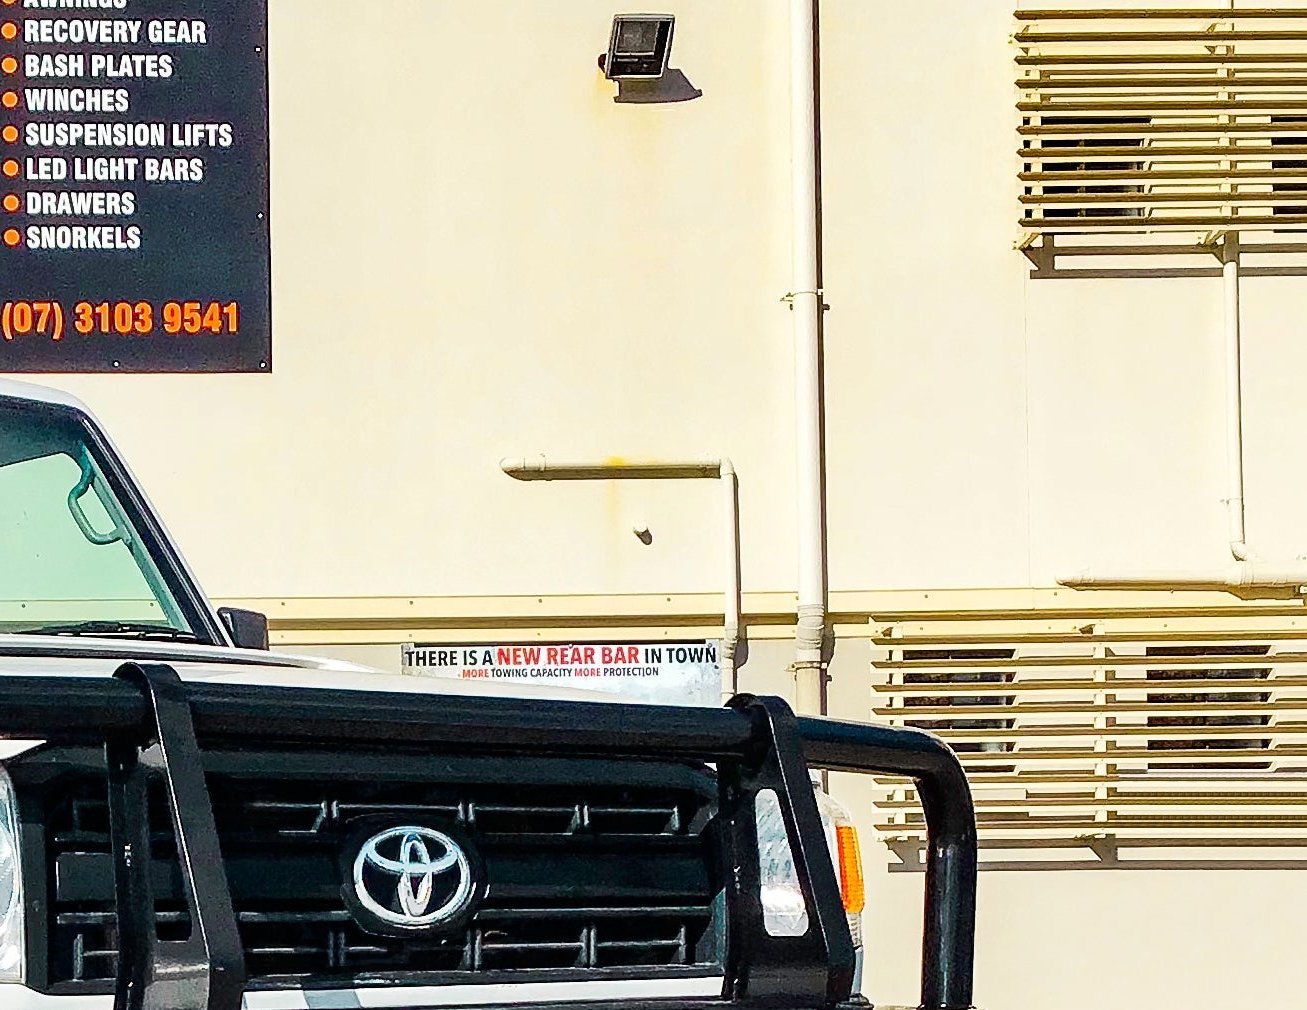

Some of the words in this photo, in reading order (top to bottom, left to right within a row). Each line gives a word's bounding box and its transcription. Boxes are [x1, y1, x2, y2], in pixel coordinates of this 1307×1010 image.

[24, 19, 142, 43] RECOVERY
[148, 20, 207, 44] GEAR
[25, 54, 84, 77] BASH
[91, 54, 173, 78] PLATES
[25, 88, 129, 112] WINCHES
[25, 123, 166, 147] SUSPENSION
[172, 123, 233, 147] LIFTS
[26, 158, 67, 180] LED
[74, 158, 139, 181] LIGHT
[145, 158, 203, 181] BARS
[26, 192, 135, 215] DRAWERS
[26, 226, 141, 250] SNORKELS
[1, 302, 64, 340] (07)
[74, 303, 153, 333] 3103
[162, 302, 238, 333] 9541
[405, 650, 458, 667] THERE
[463, 649, 478, 666] IS
[482, 650, 493, 666] A
[497, 647, 542, 666] NEW
[546, 647, 595, 666] REAR
[601, 646, 640, 665] BAR
[645, 648, 662, 664] IN
[666, 647, 717, 664] TOWN
[462, 669, 490, 679] MORE
[491, 668, 528, 678] TOWING
[530, 667, 573, 678] CAPACITY
[574, 667, 601, 677] MORE
[603, 667, 659, 677] PROTECTION
